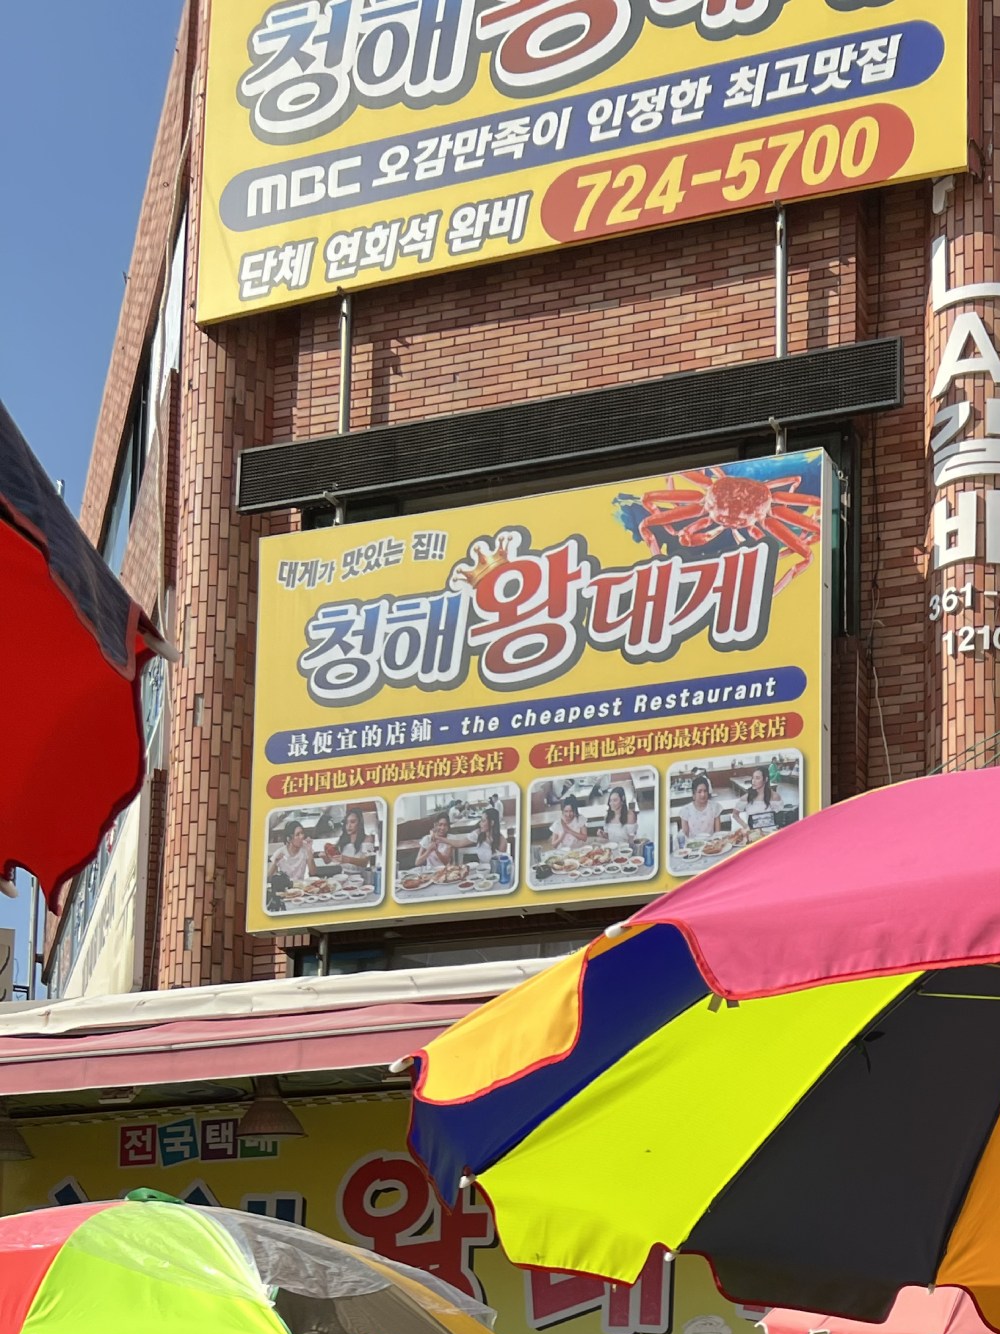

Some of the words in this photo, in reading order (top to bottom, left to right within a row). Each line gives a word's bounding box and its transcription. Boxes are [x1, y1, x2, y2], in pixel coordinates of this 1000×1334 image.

[373, 107, 570, 187] 오감만족이
[588, 83, 712, 142] 인정한
[724, 35, 903, 106] 최고맛집
[572, 116, 879, 233] 724-5700
[239, 246, 315, 299] 단체
[326, 220, 440, 284] 연회석
[449, 193, 531, 252] 완비
[277, 557, 336, 590] 대게가
[341, 538, 404, 578] 맛있는
[412, 530, 446, 563] 집!!
[300, 540, 772, 702] 청해왕대게
[287, 717, 432, 758] 最便宜的店鋪
[460, 711, 500, 736] the
[511, 697, 622, 735] cheapest
[634, 676, 777, 715] Restaurant
[545, 716, 786, 764] 在中國也認可的最好的美食店
[281, 751, 504, 794] 在中国也认可的最好的美食店
[125, 1126, 194, 1161] 전국
